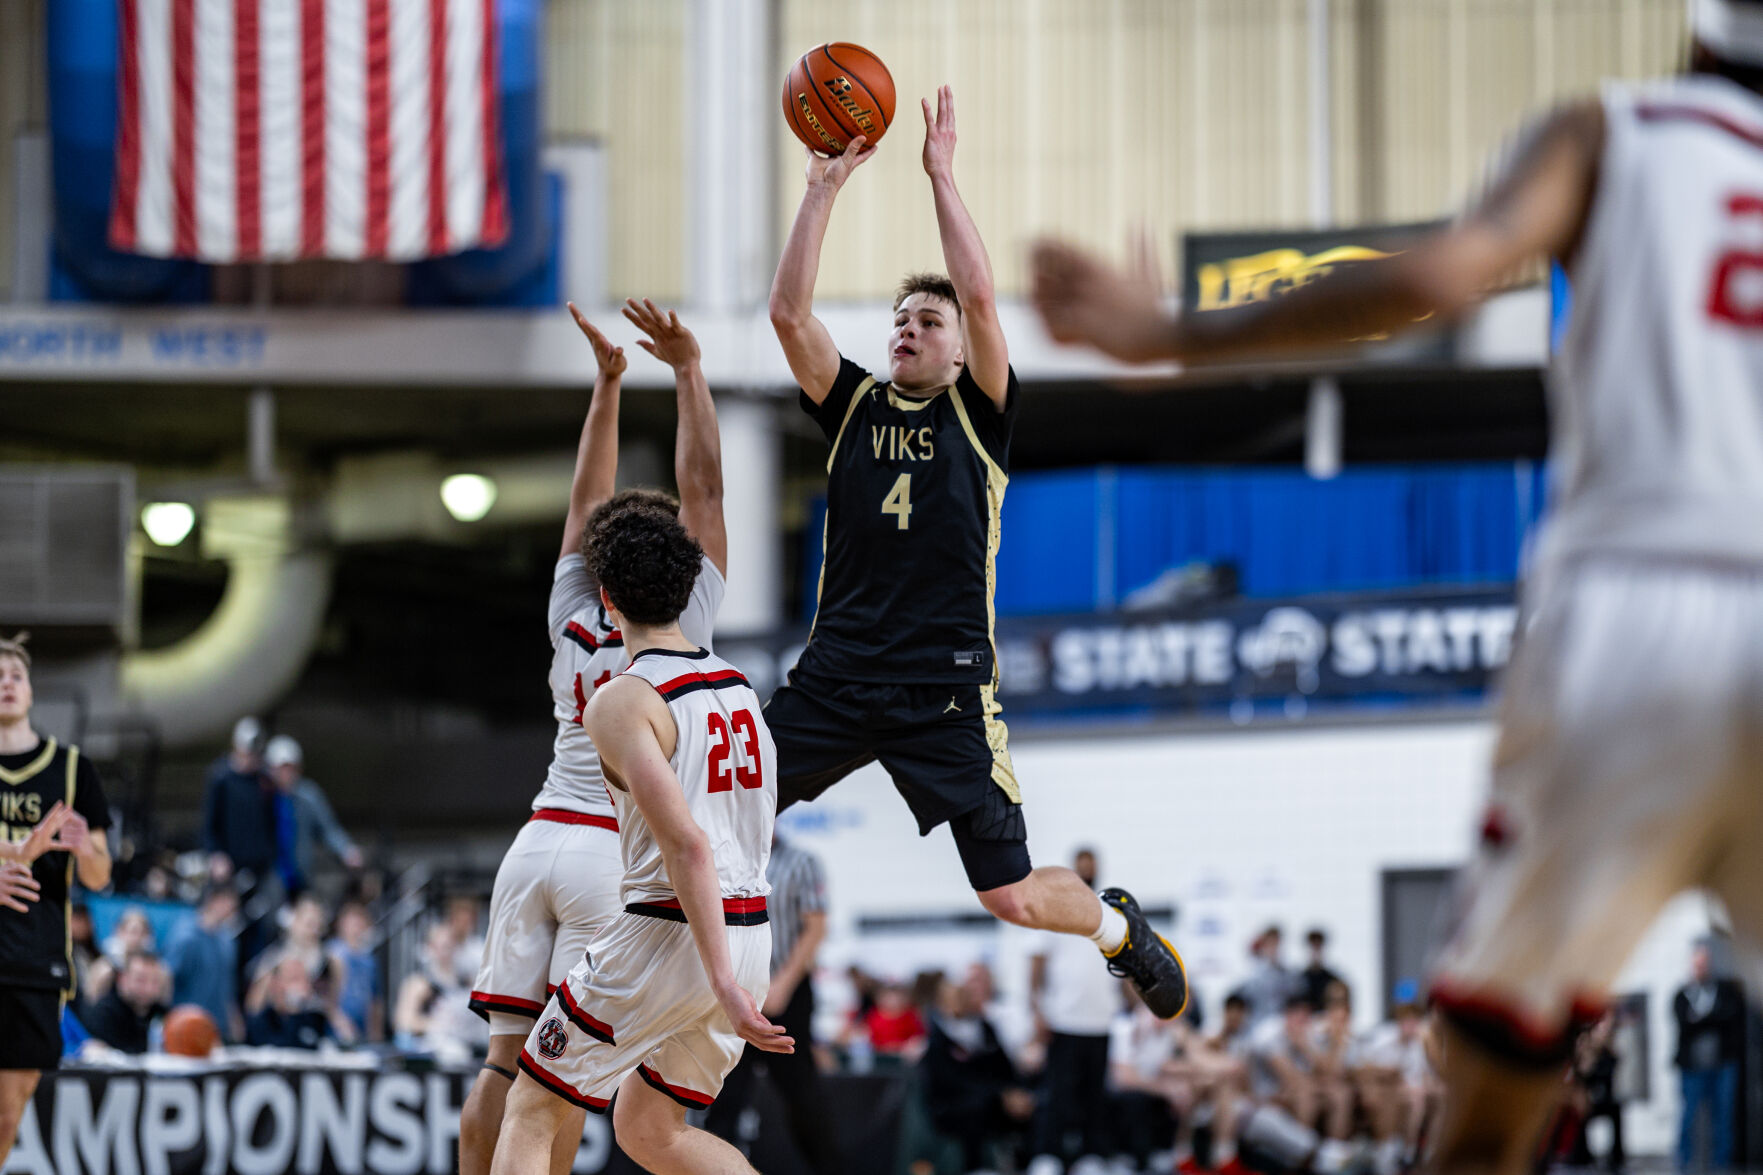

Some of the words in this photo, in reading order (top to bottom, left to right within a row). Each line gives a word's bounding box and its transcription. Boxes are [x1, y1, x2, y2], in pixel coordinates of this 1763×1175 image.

[824, 76, 877, 134] Baden
[152, 325, 266, 366] WEST
[872, 425, 934, 461] VIKS
[881, 472, 912, 529] 4
[1051, 620, 1234, 694] STATE
[707, 708, 763, 793] 23
[0, 791, 42, 823] IKS
